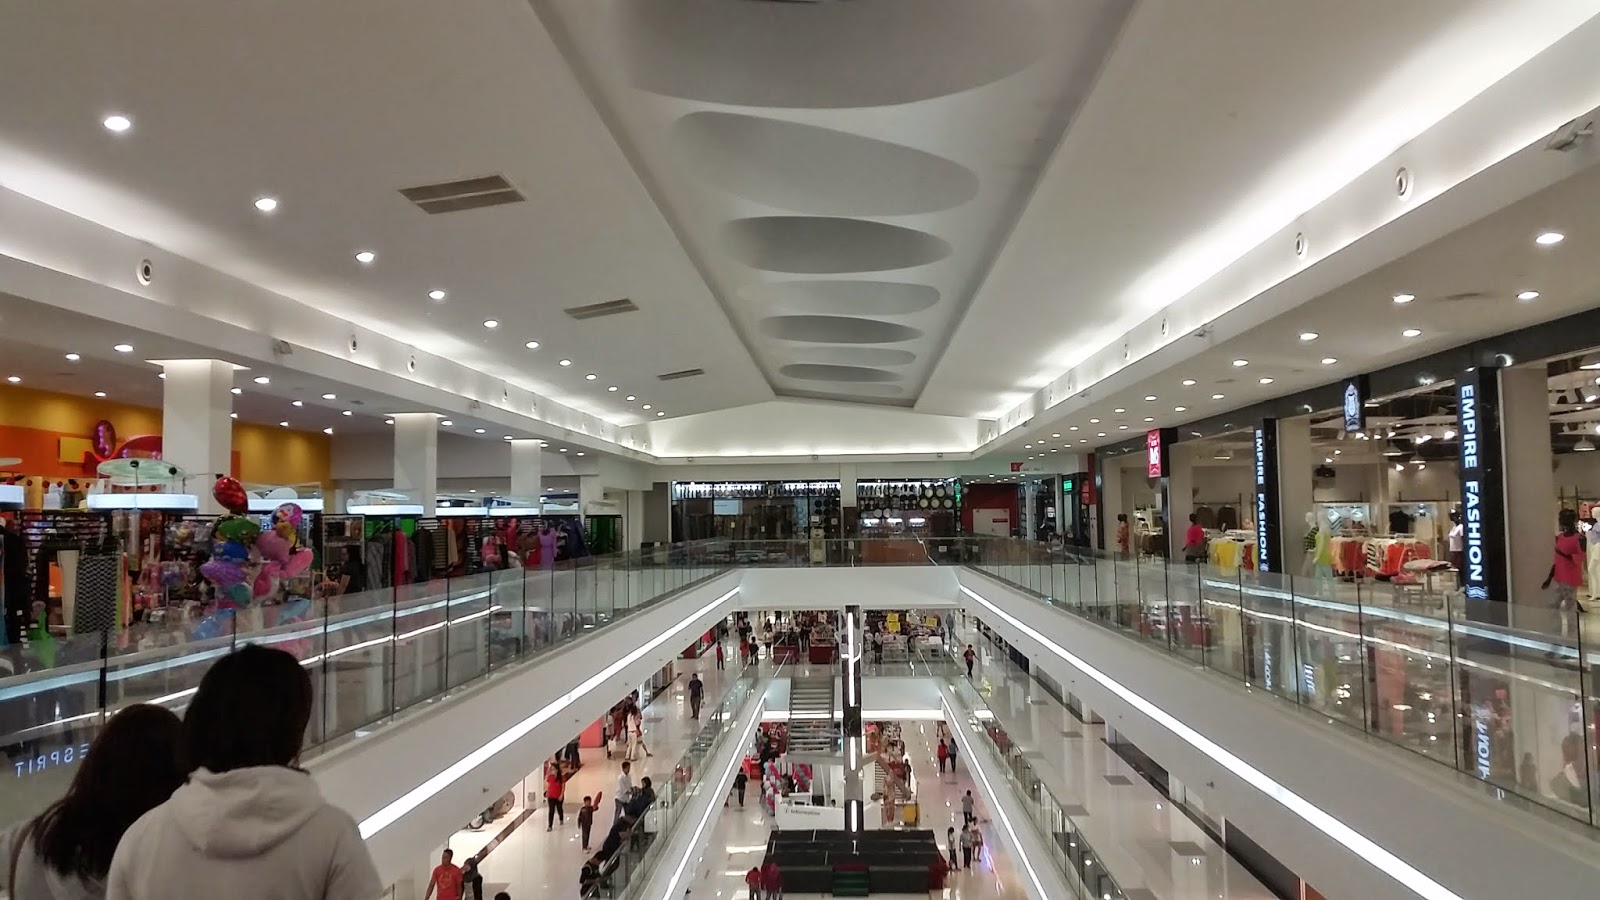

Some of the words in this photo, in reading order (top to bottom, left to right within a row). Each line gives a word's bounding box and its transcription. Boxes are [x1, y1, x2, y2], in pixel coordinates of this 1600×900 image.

[1255, 429, 1264, 484] EMPIRE
[1461, 385, 1478, 468] EMPIRE
[1257, 493, 1267, 560] FASHION
[1465, 480, 1482, 581] FASHION
